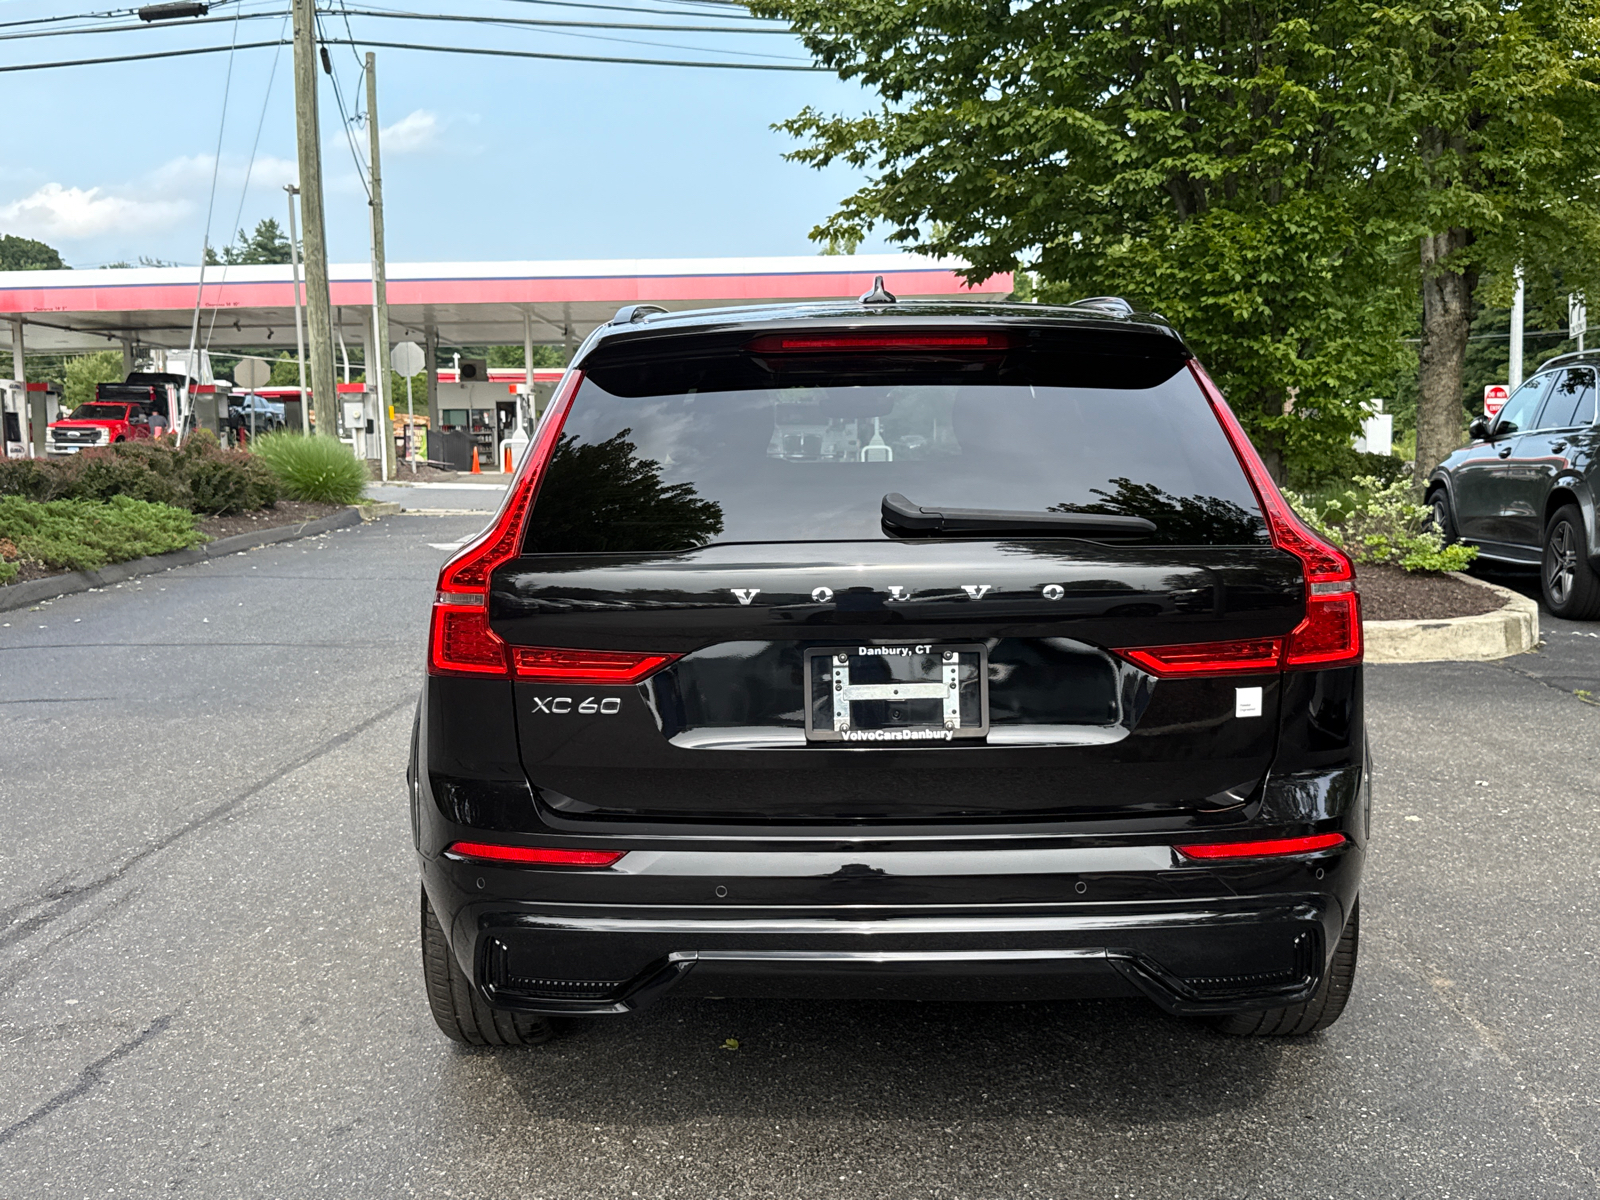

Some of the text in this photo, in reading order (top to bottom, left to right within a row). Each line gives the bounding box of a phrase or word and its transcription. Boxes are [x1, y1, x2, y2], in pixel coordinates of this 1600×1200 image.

[730, 584, 1065, 606] VOLVO
[858, 645, 932, 657] Danbury, CT
[841, 729, 954, 741] VolvoCarsDanbury
